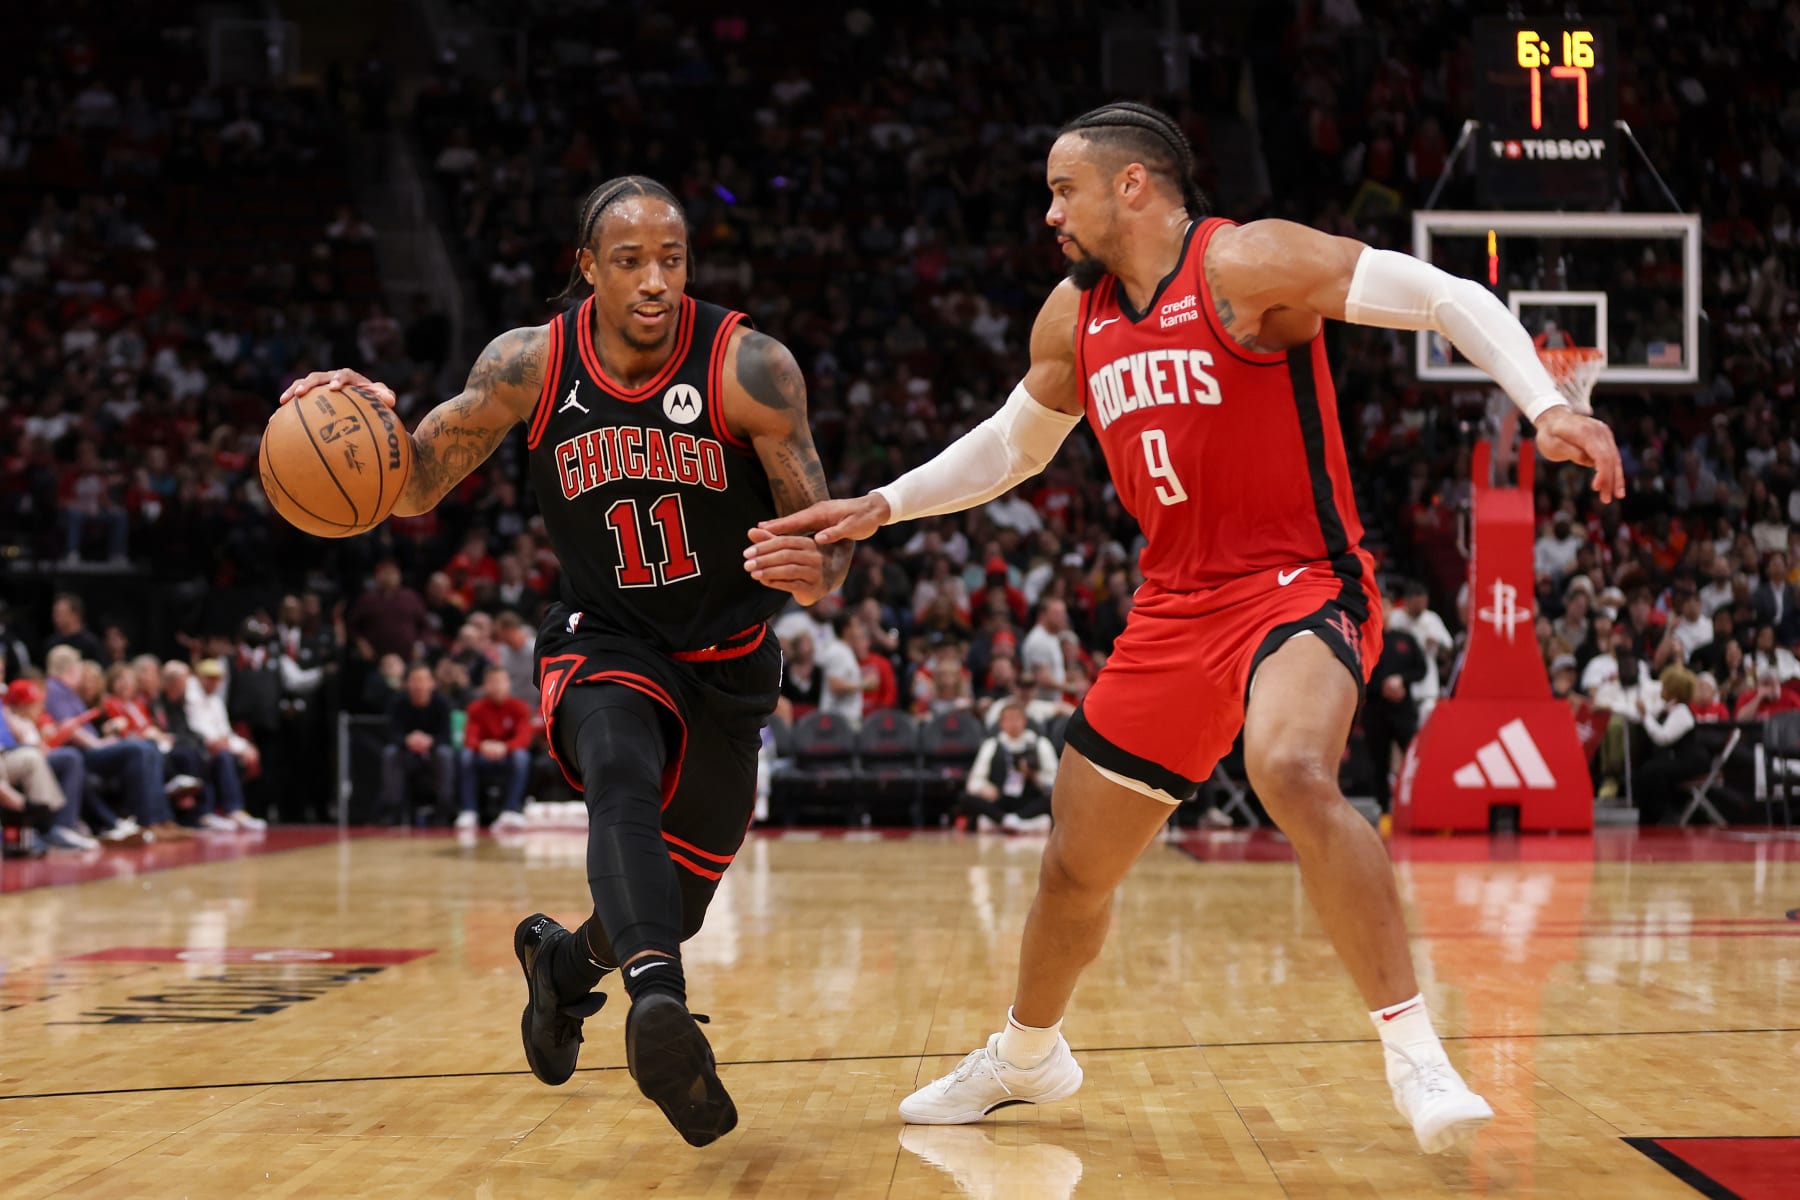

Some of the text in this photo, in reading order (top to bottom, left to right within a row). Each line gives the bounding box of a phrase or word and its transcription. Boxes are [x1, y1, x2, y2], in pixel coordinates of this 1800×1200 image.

[1517, 30, 1595, 68] 6:16
[1529, 65, 1589, 130] 17
[1522, 139, 1606, 159] TISSOT
[1160, 309, 1199, 329] karma
[1161, 294, 1197, 315] credit
[1088, 349, 1222, 430] ROCKETS
[554, 425, 728, 501] CHICAGO
[1140, 428, 1189, 506] 9
[604, 492, 701, 589] 11
